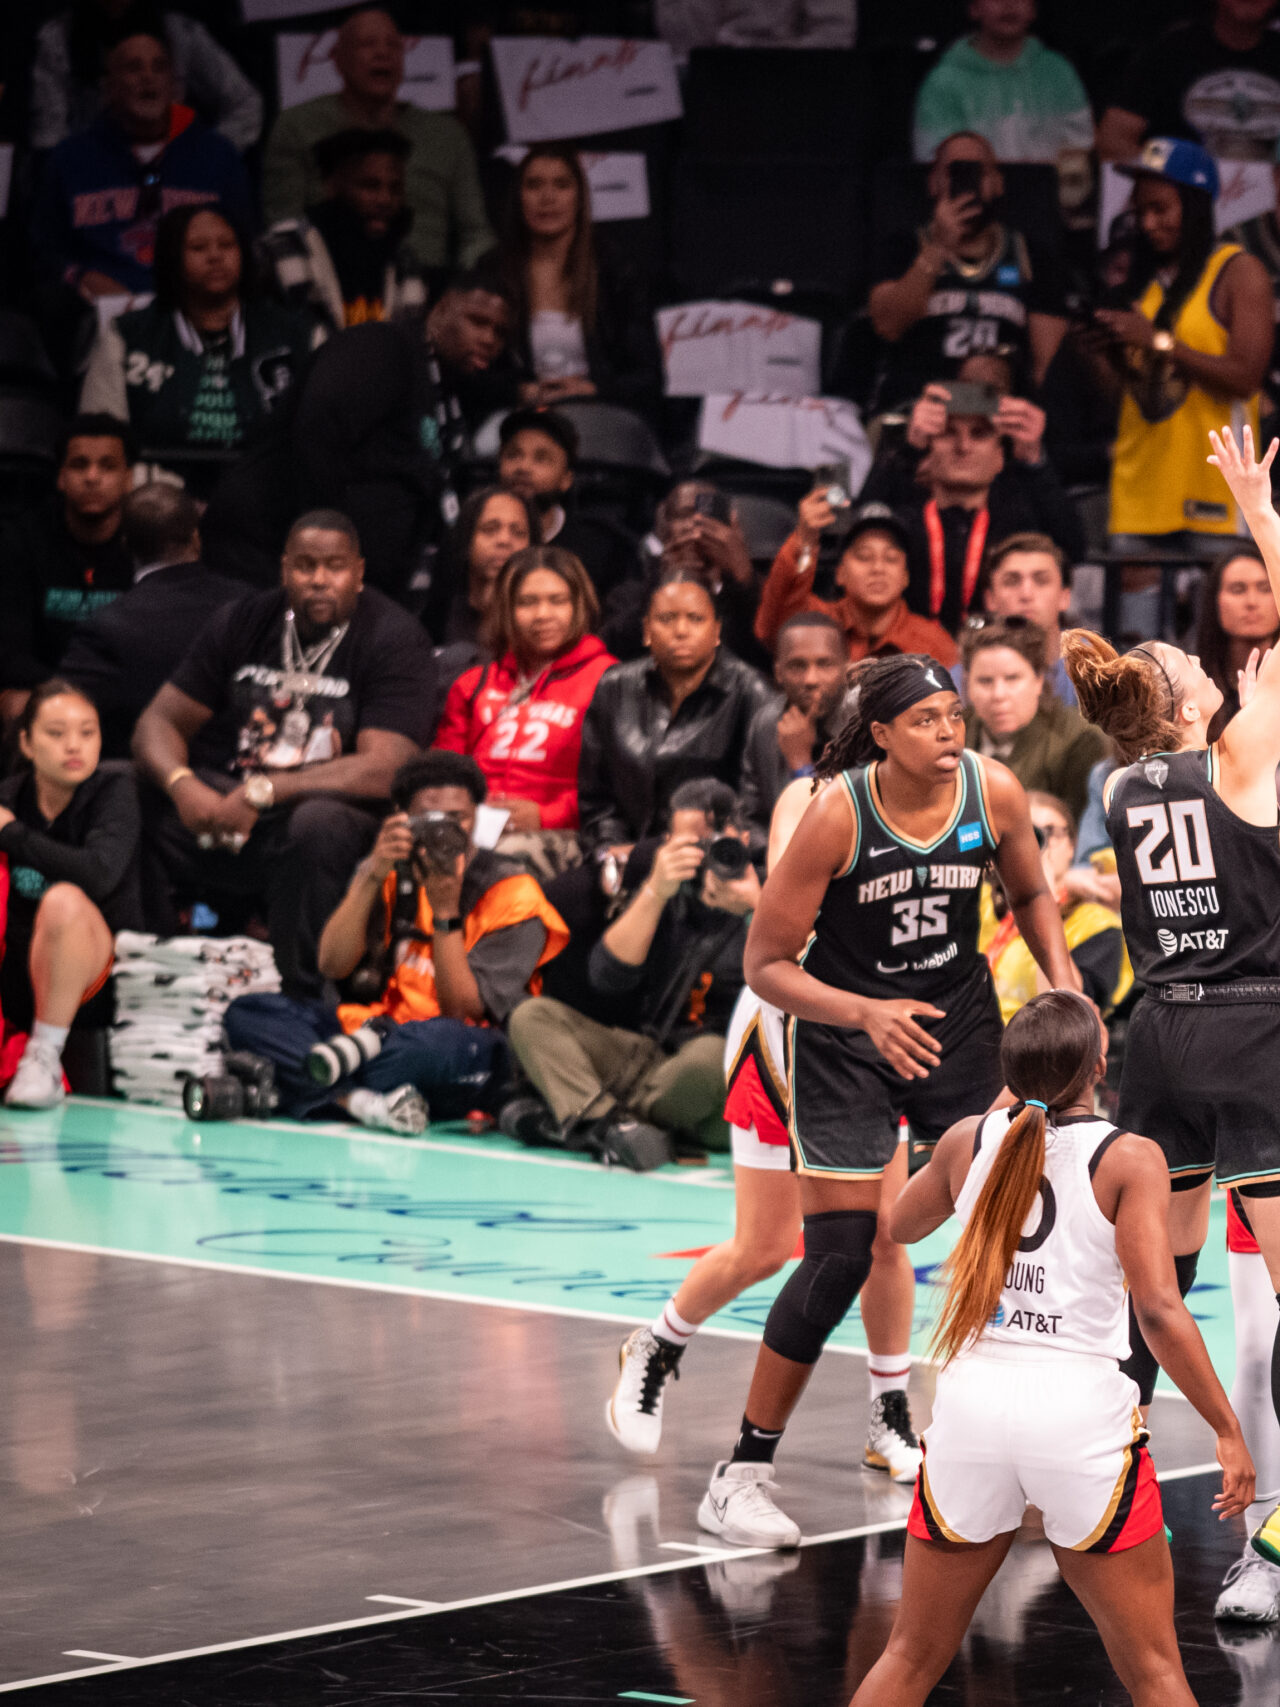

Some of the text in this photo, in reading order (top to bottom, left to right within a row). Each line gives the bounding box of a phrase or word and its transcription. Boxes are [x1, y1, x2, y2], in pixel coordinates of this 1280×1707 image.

[489, 719, 549, 762] 22
[1126, 799, 1217, 885] 20
[858, 864, 981, 904] NEW YORK
[1150, 886, 1220, 918] IONESCU
[891, 894, 950, 947] 35
[1179, 929, 1229, 953] AT&T
[1004, 1262, 1045, 1294] OUNG
[1007, 1309, 1063, 1335] AT&T
